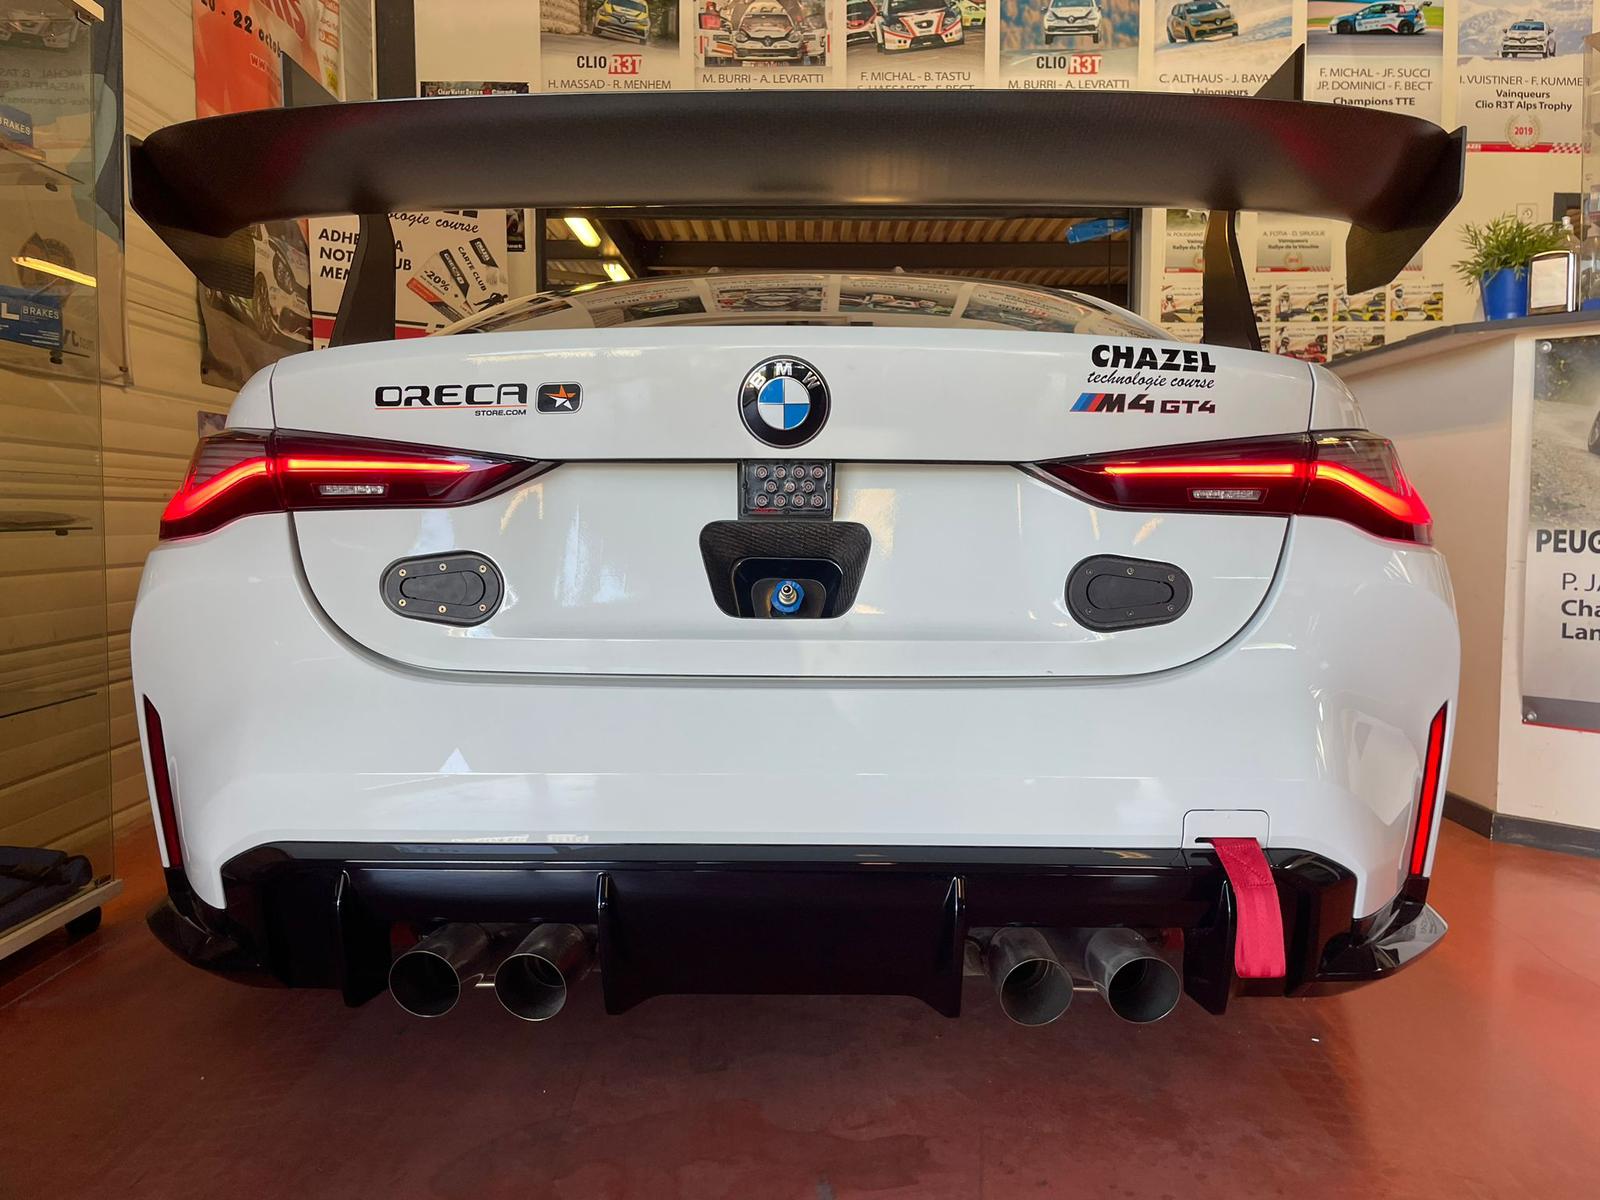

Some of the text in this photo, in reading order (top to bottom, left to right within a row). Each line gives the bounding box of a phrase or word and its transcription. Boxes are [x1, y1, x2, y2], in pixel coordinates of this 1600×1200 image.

[233, 10, 252, 34] 22
[577, 55, 641, 73] CLIO R3T
[1036, 55, 1102, 74] CLIO R3T
[702, 74, 716, 83] M.
[719, 74, 751, 83] BURRI
[760, 74, 770, 83] A.
[773, 74, 824, 83] LEVRATTI
[861, 72, 868, 81] F.
[871, 72, 914, 81] MICHAL
[925, 72, 934, 81] B.
[936, 72, 971, 81] TASTU
[1159, 74, 1169, 83] C.
[1172, 74, 1223, 83] ALTHAUS
[1231, 74, 1239, 83] J.
[1242, 74, 1273, 83] BAYA
[1320, 68, 1327, 77] F.
[1330, 68, 1373, 77] MICHAL
[1381, 68, 1395, 77] JF.
[1397, 68, 1431, 78] SUCCI
[1467, 75, 1523, 85] VUISTINER
[1531, 76, 1539, 85] F.
[548, 80, 558, 88] H.
[561, 80, 605, 88] MASSAD
[613, 80, 621, 89] R.
[624, 80, 671, 89] MENHEM
[1008, 80, 1020, 89] M.
[1024, 80, 1056, 89] BURRI
[1066, 80, 1075, 89] A.
[1079, 80, 1129, 89] LEVRATTI
[1317, 81, 1329, 90] JP.
[1332, 81, 1385, 90] DOMINICI
[1394, 81, 1401, 90] F.
[1404, 81, 1432, 91] BECT
[1496, 89, 1550, 99] Vainqueurs
[1333, 97, 1415, 107] Champions TTE
[1475, 100, 1572, 112] Clio R3T Alps Trophy
[1515, 127, 1533, 135] 2019
[436, 218, 479, 233] course
[458, 246, 487, 291] CARTE CLUB
[424, 270, 450, 292] -20%
[23, 305, 59, 320] BRAKES
[1091, 344, 1216, 373] CHAZEL
[750, 361, 821, 391] BMW
[1087, 369, 1214, 390] technologie course
[375, 383, 528, 407] ORECA
[1094, 393, 1216, 414] M4 GT4
[475, 409, 527, 417] STORE.COM
[1536, 529, 1600, 554] PEUG
[1562, 573, 1600, 591] P. J
[1561, 622, 1600, 641] Lan
